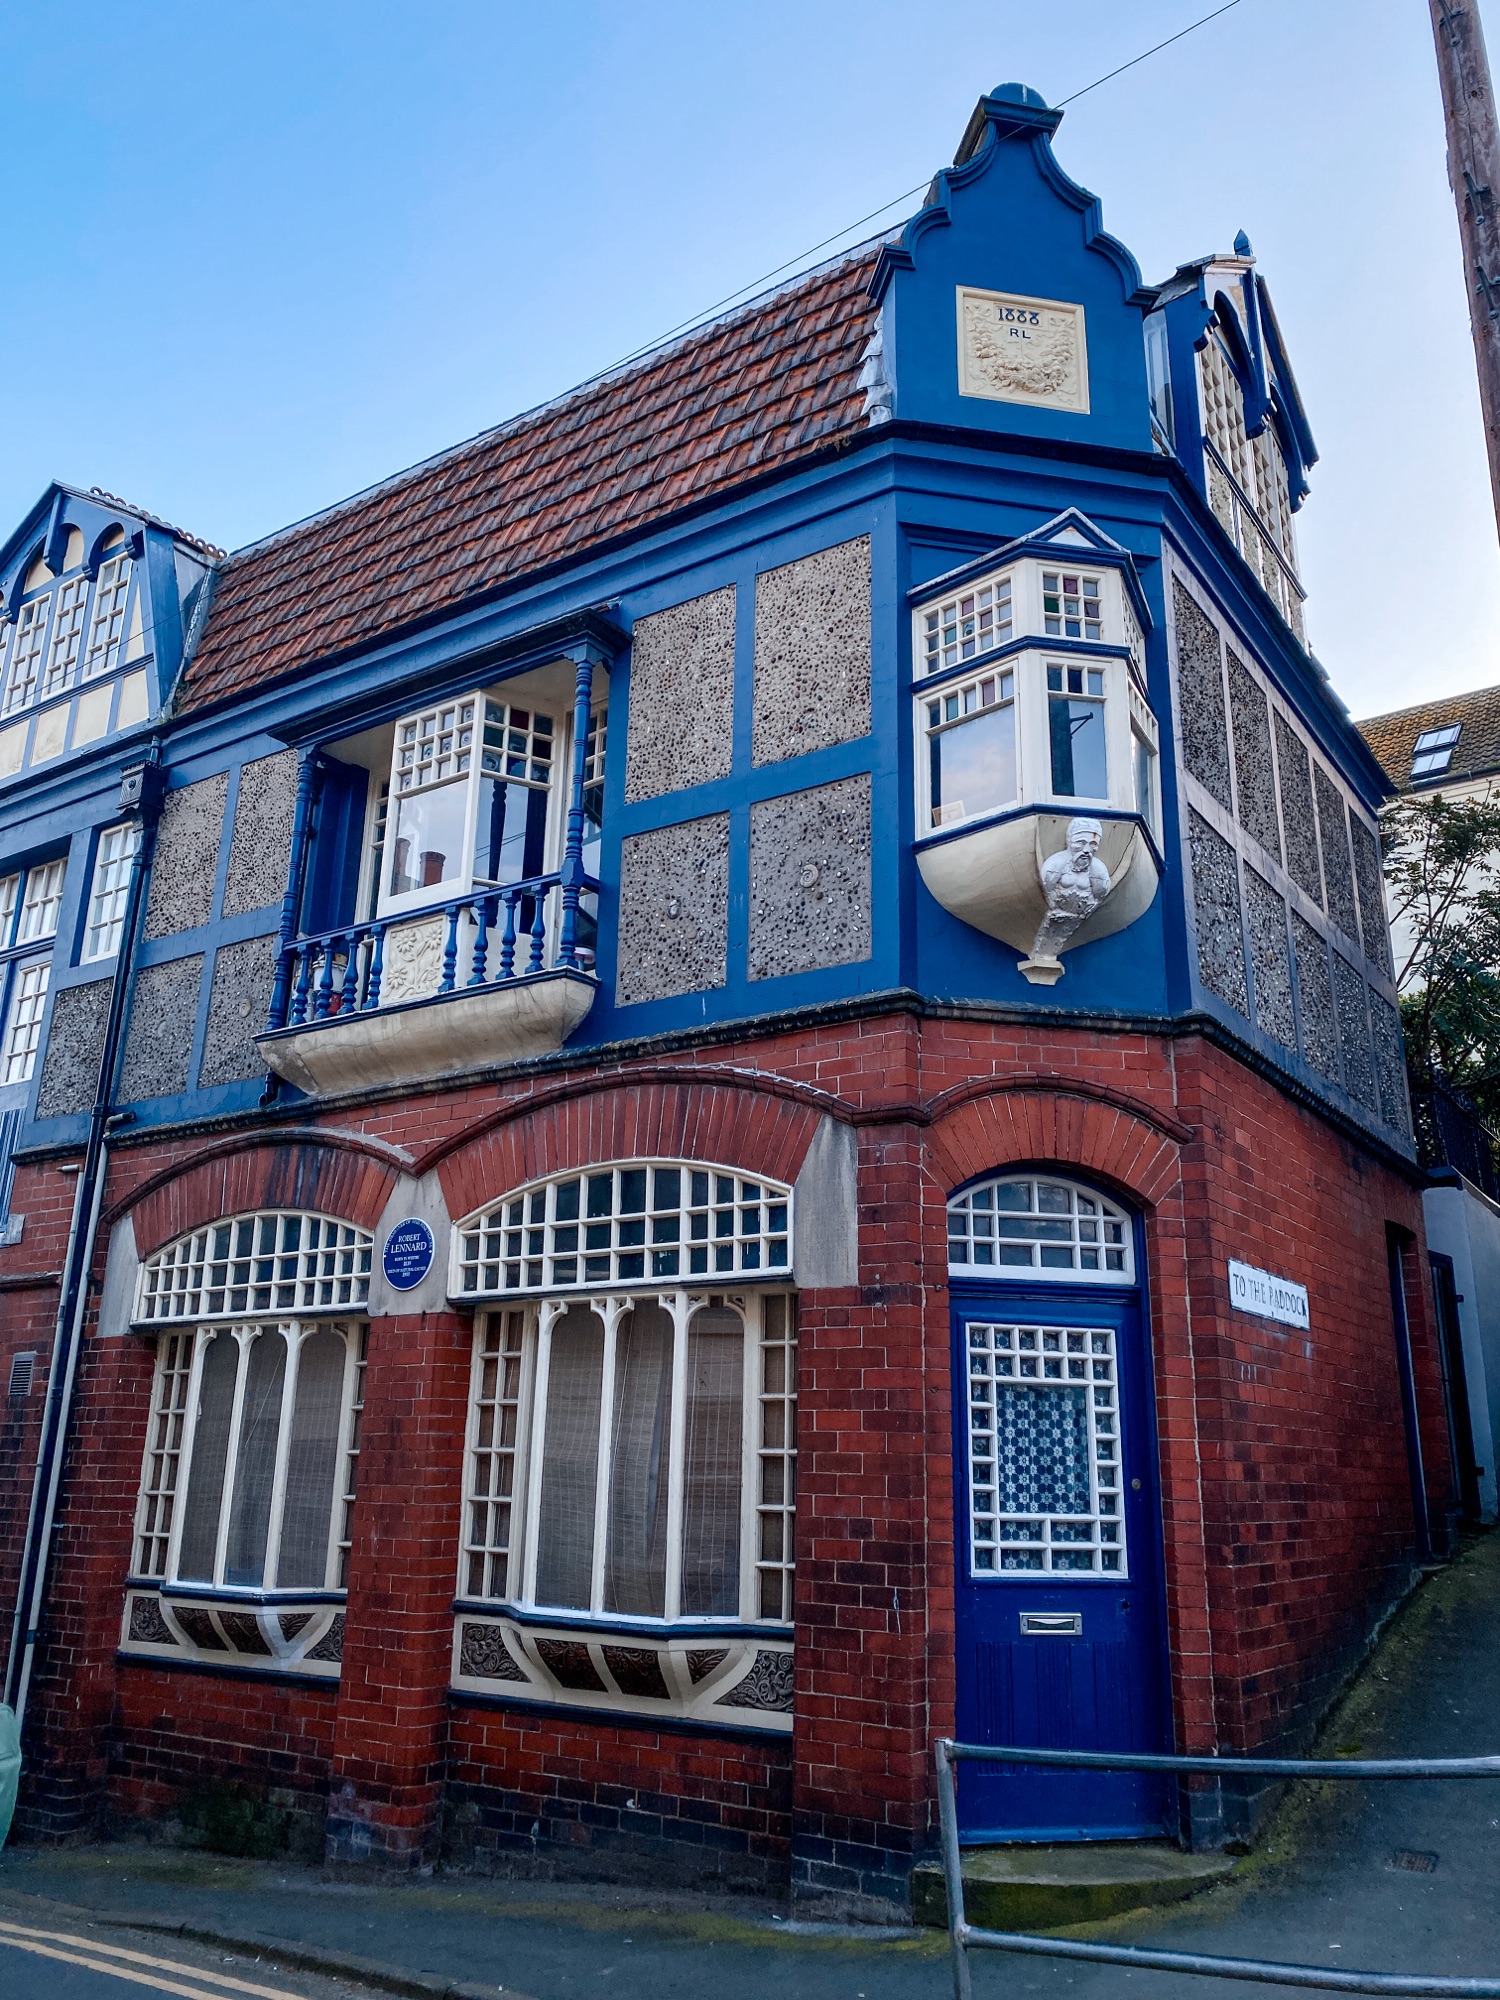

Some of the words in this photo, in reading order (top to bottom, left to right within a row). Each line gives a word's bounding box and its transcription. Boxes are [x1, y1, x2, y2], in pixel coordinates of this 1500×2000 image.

[998, 308, 1040, 326] 1888
[398, 1234, 421, 1242] ROBERT
[390, 1242, 427, 1253] LENNARD
[1233, 1273, 1246, 1297] TO
[1248, 1278, 1266, 1305] THE
[1268, 1286, 1307, 1317] PADDOCK
